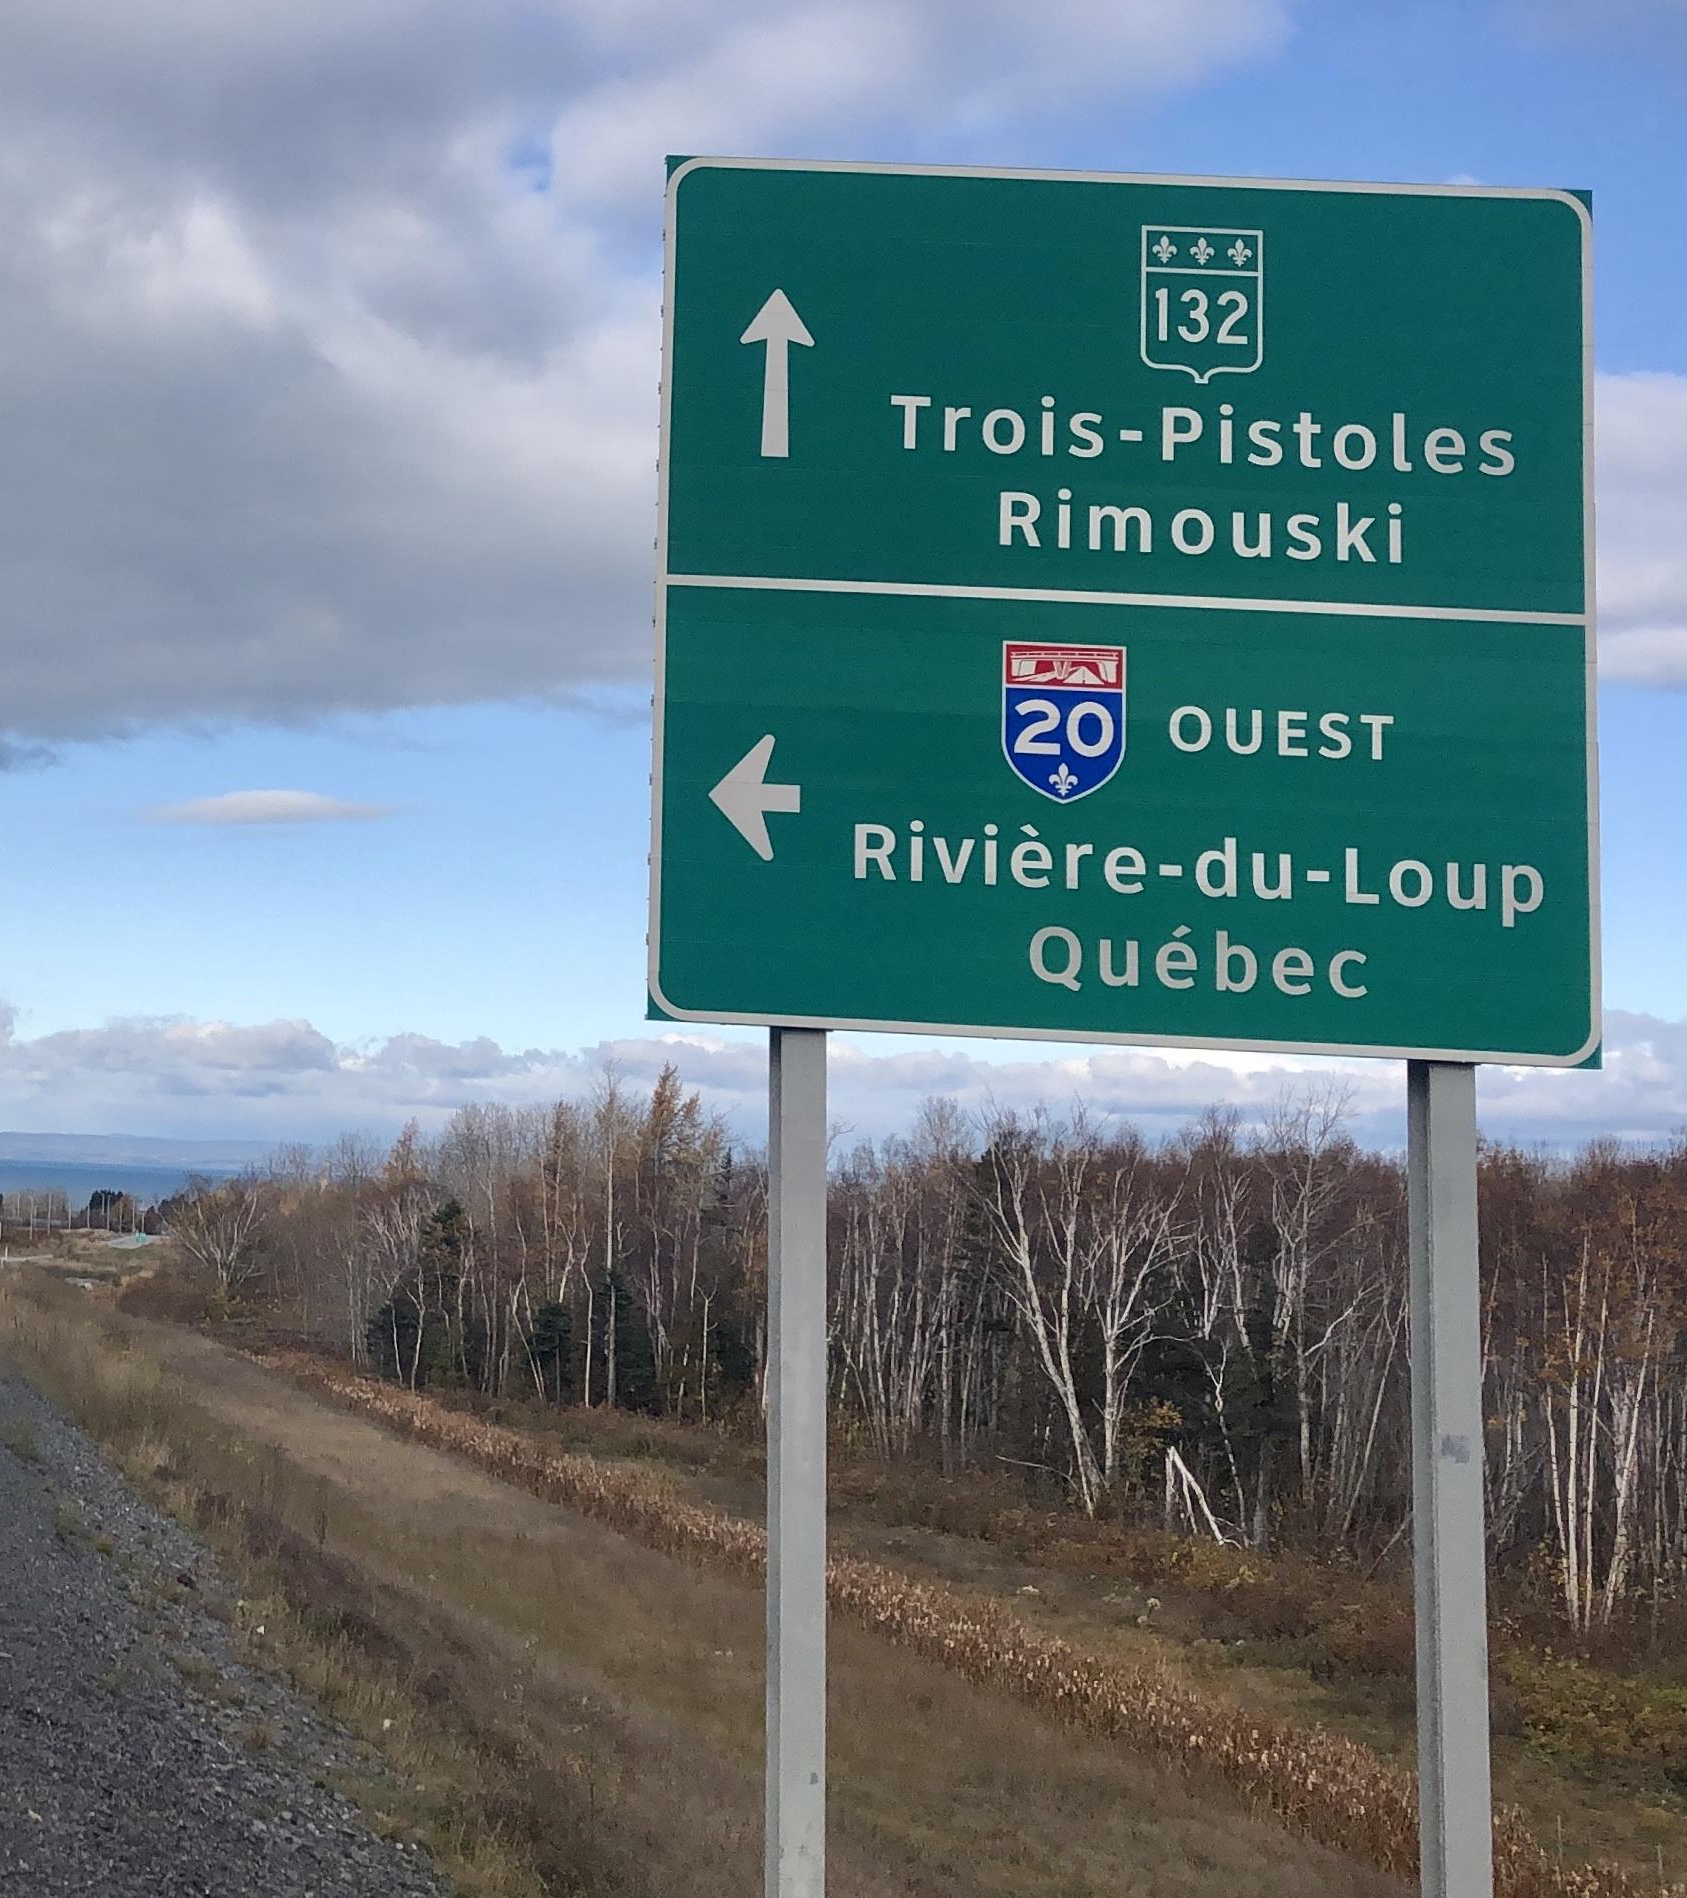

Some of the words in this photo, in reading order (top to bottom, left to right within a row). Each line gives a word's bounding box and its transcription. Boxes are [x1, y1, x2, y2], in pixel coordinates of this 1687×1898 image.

[1153, 287, 1250, 346] 132
[891, 395, 1515, 476] Trois-Pistoles
[999, 488, 1402, 563] Rimouski
[1012, 698, 1115, 758] 20
[1169, 705, 1394, 760] OUEST
[854, 820, 1544, 928] Rivière-du-Loup
[1029, 925, 1368, 998] Québec
